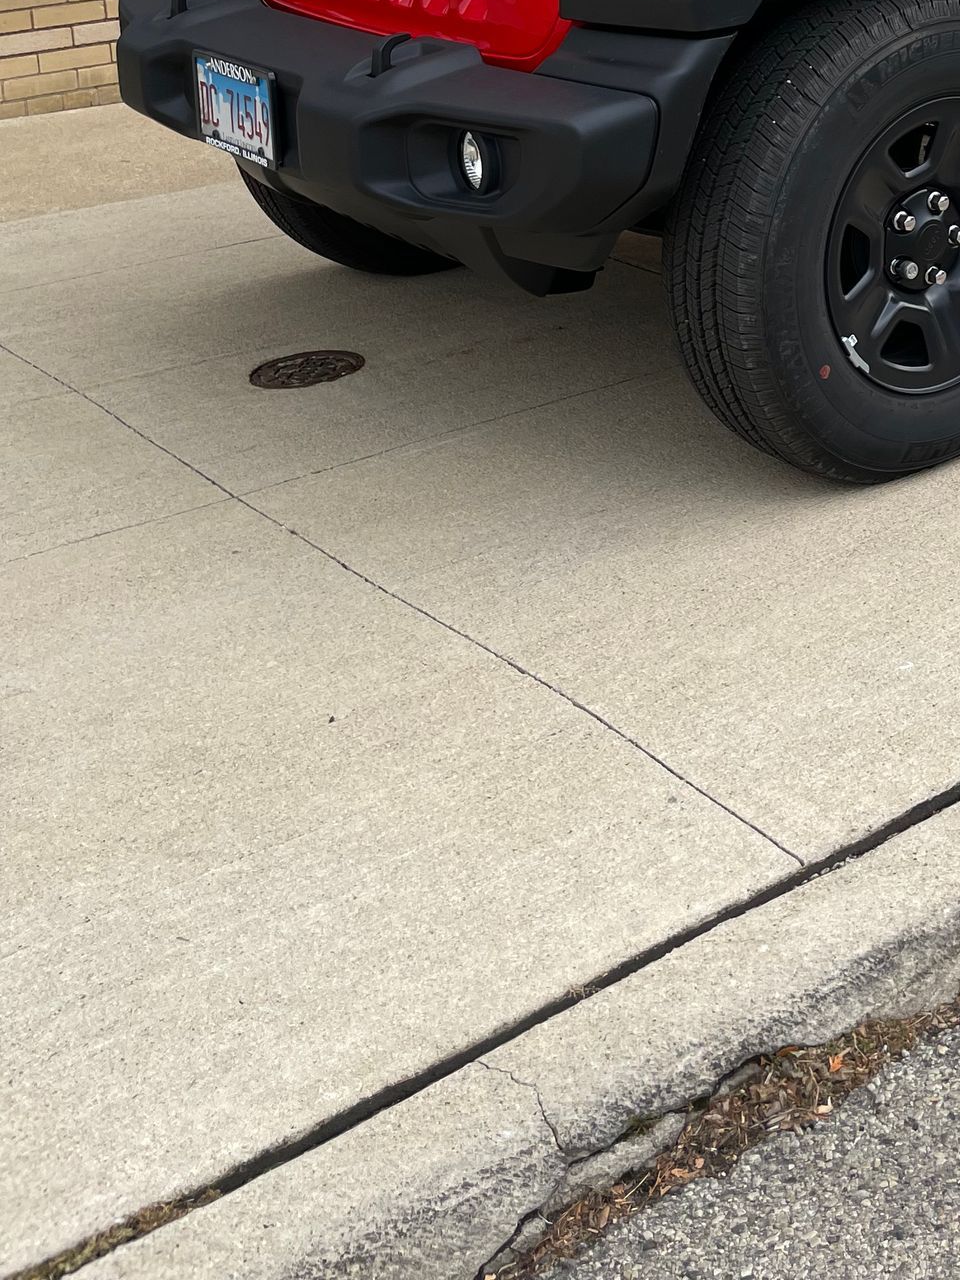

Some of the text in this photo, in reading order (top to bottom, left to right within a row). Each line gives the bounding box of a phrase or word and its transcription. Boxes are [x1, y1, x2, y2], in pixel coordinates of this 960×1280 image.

[209, 57, 253, 84] ANDERSON
[200, 80, 269, 146] DC 74549
[242, 149, 268, 168] ILLINOIS
